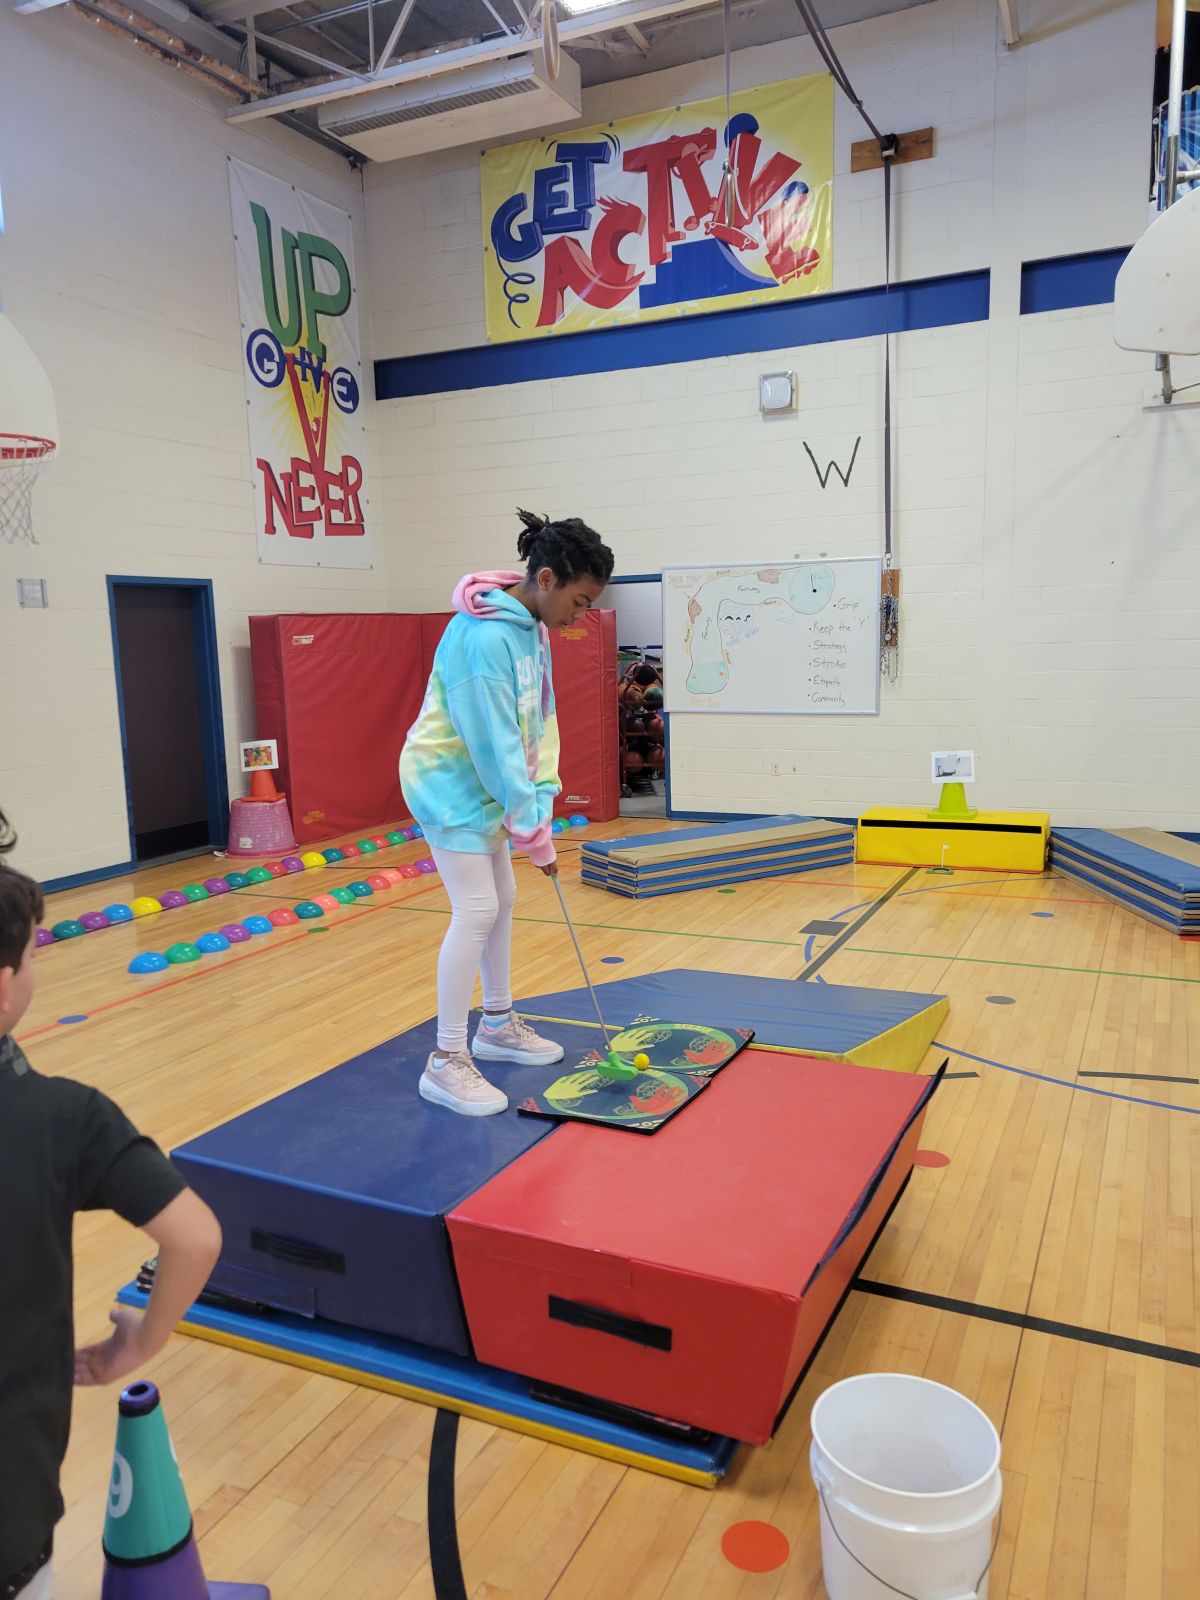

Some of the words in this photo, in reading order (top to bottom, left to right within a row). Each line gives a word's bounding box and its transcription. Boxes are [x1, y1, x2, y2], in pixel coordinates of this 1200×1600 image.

[490, 141, 613, 262] GET
[249, 200, 352, 363] UP
[246, 328, 360, 414] GIVE
[802, 435, 862, 489] W
[812, 619, 834, 635] Keep
[838, 619, 851, 632] the
[812, 639, 848, 654] Strategy
